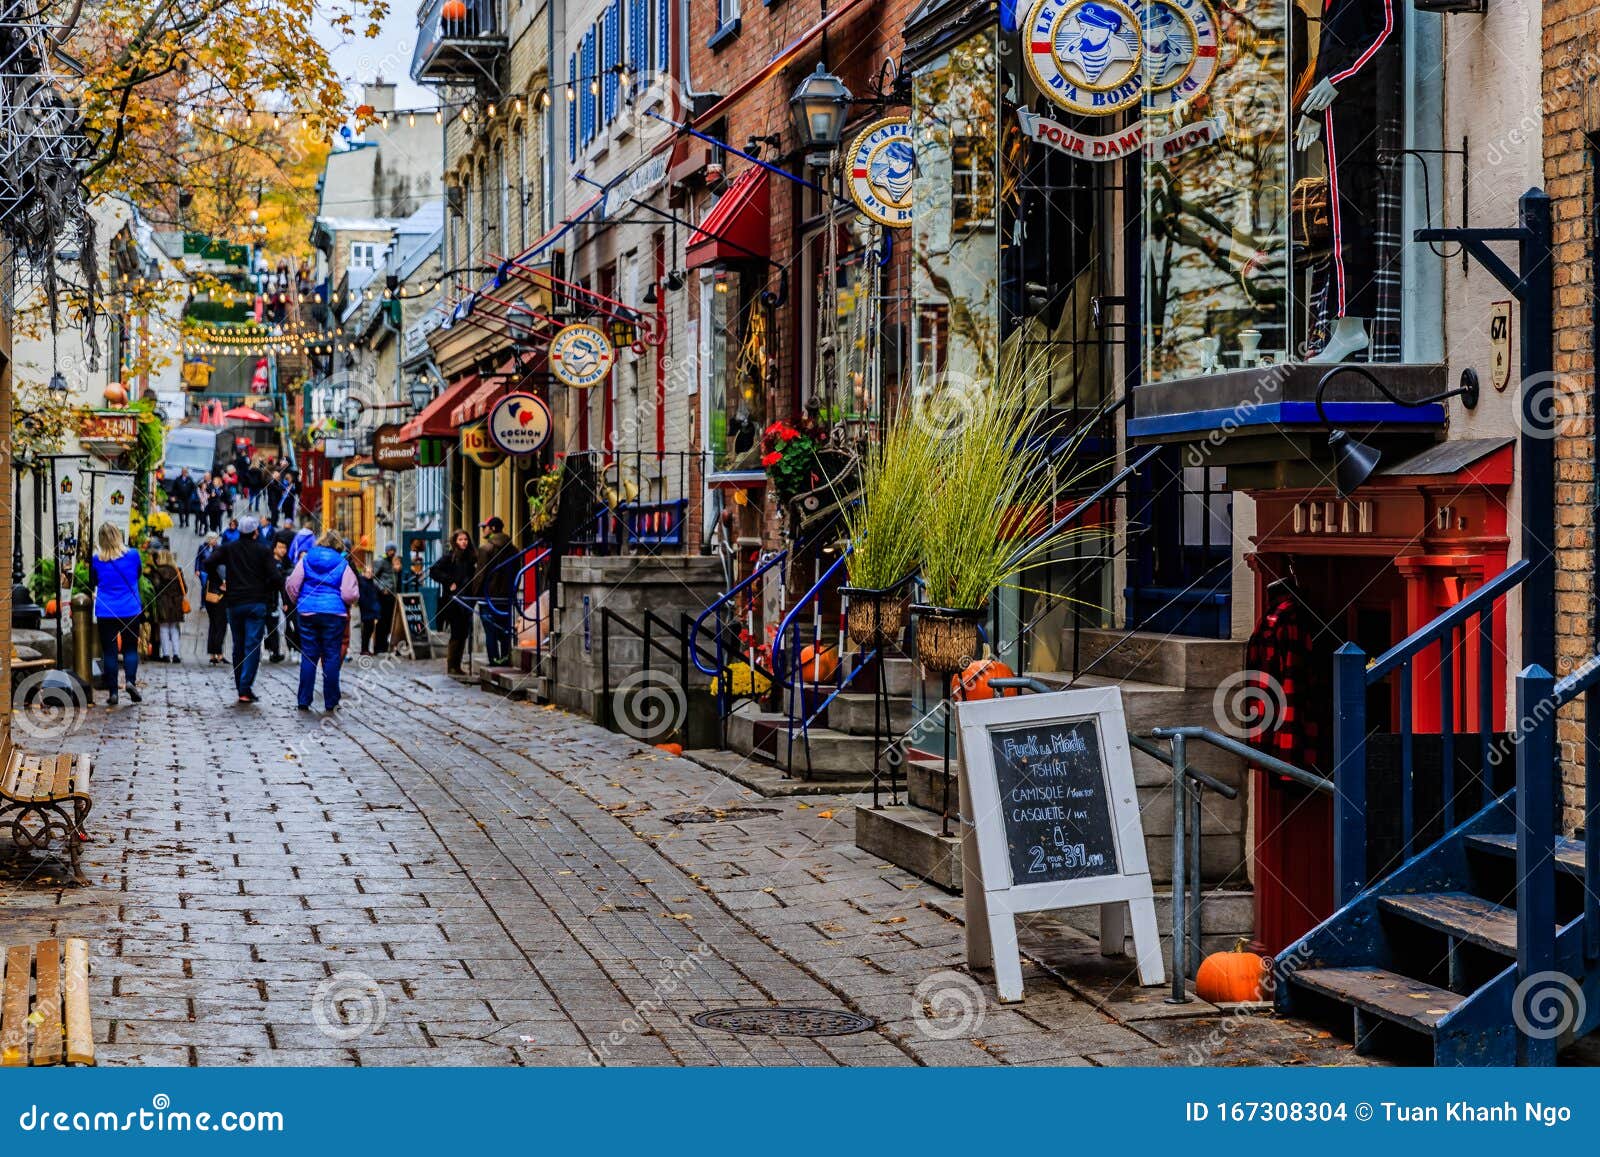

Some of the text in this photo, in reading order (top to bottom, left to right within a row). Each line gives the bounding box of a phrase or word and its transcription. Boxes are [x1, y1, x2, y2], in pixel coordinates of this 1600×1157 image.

[1037, 7, 1056, 34] LE
[857, 125, 913, 165] LE CAPI
[1038, 123, 1084, 155] POUR
[500, 429, 541, 438] COCHON
[1293, 501, 1373, 534] OCLAN
[1012, 786, 1064, 803] CAMISOLE
[1013, 806, 1064, 822] CASQUETTE
[1074, 810, 1088, 819] HAT
[1028, 845, 1047, 873] 2
